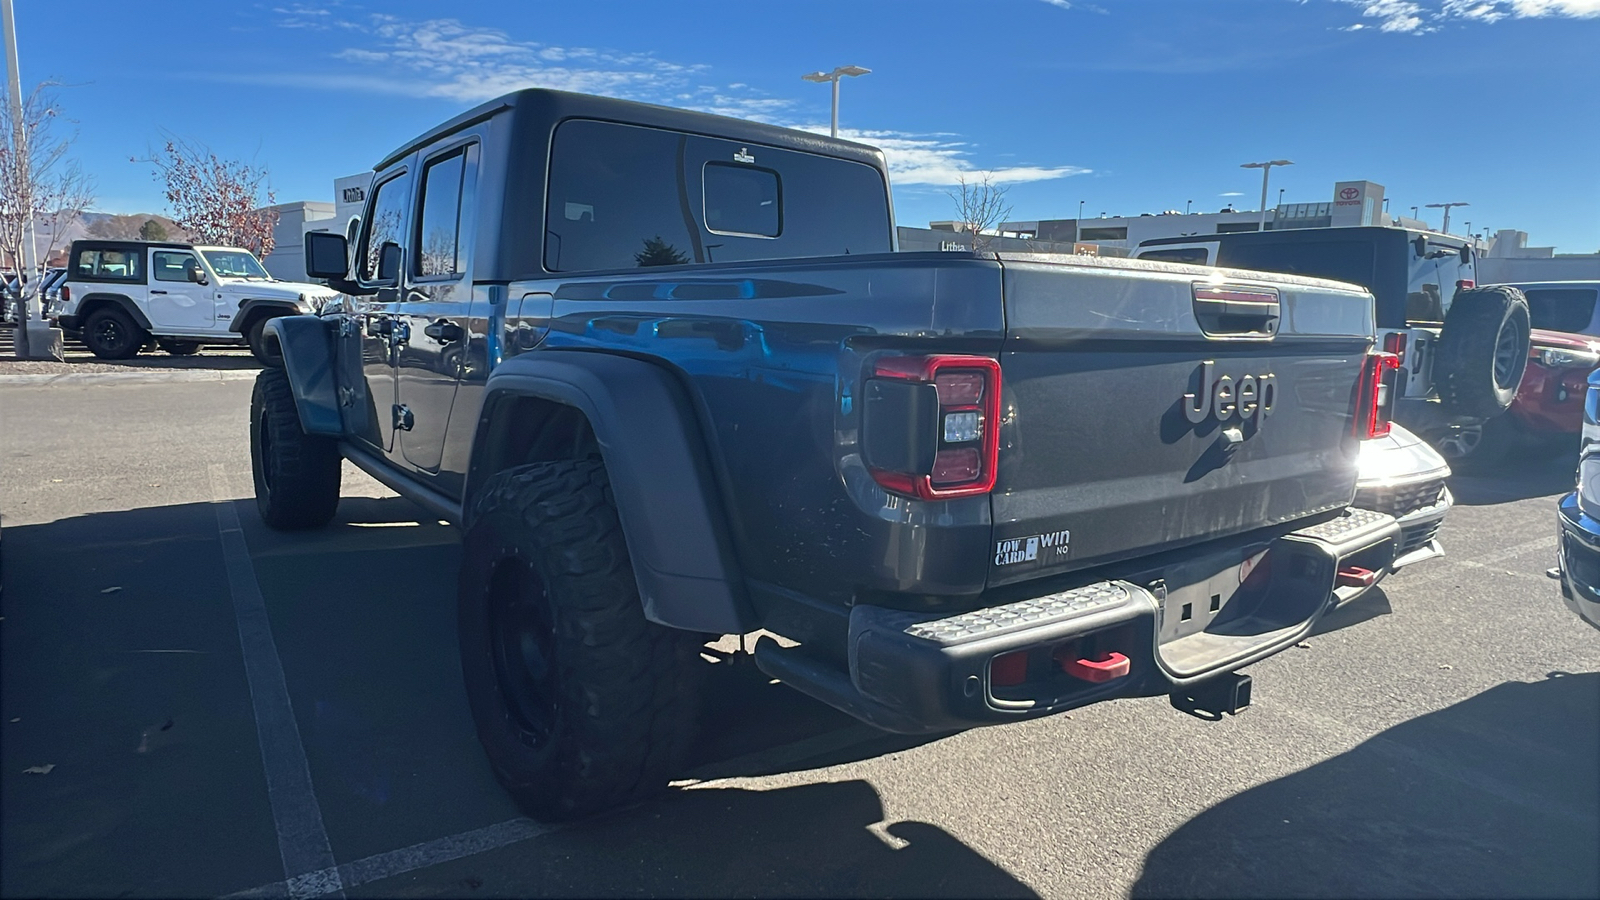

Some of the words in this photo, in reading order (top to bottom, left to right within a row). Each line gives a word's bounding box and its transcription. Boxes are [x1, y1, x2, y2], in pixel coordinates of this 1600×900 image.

[1184, 360, 1278, 431] Jeep
[996, 540, 1021, 555] LOW
[1056, 545, 1069, 555] NO
[994, 550, 1026, 566] CARD
